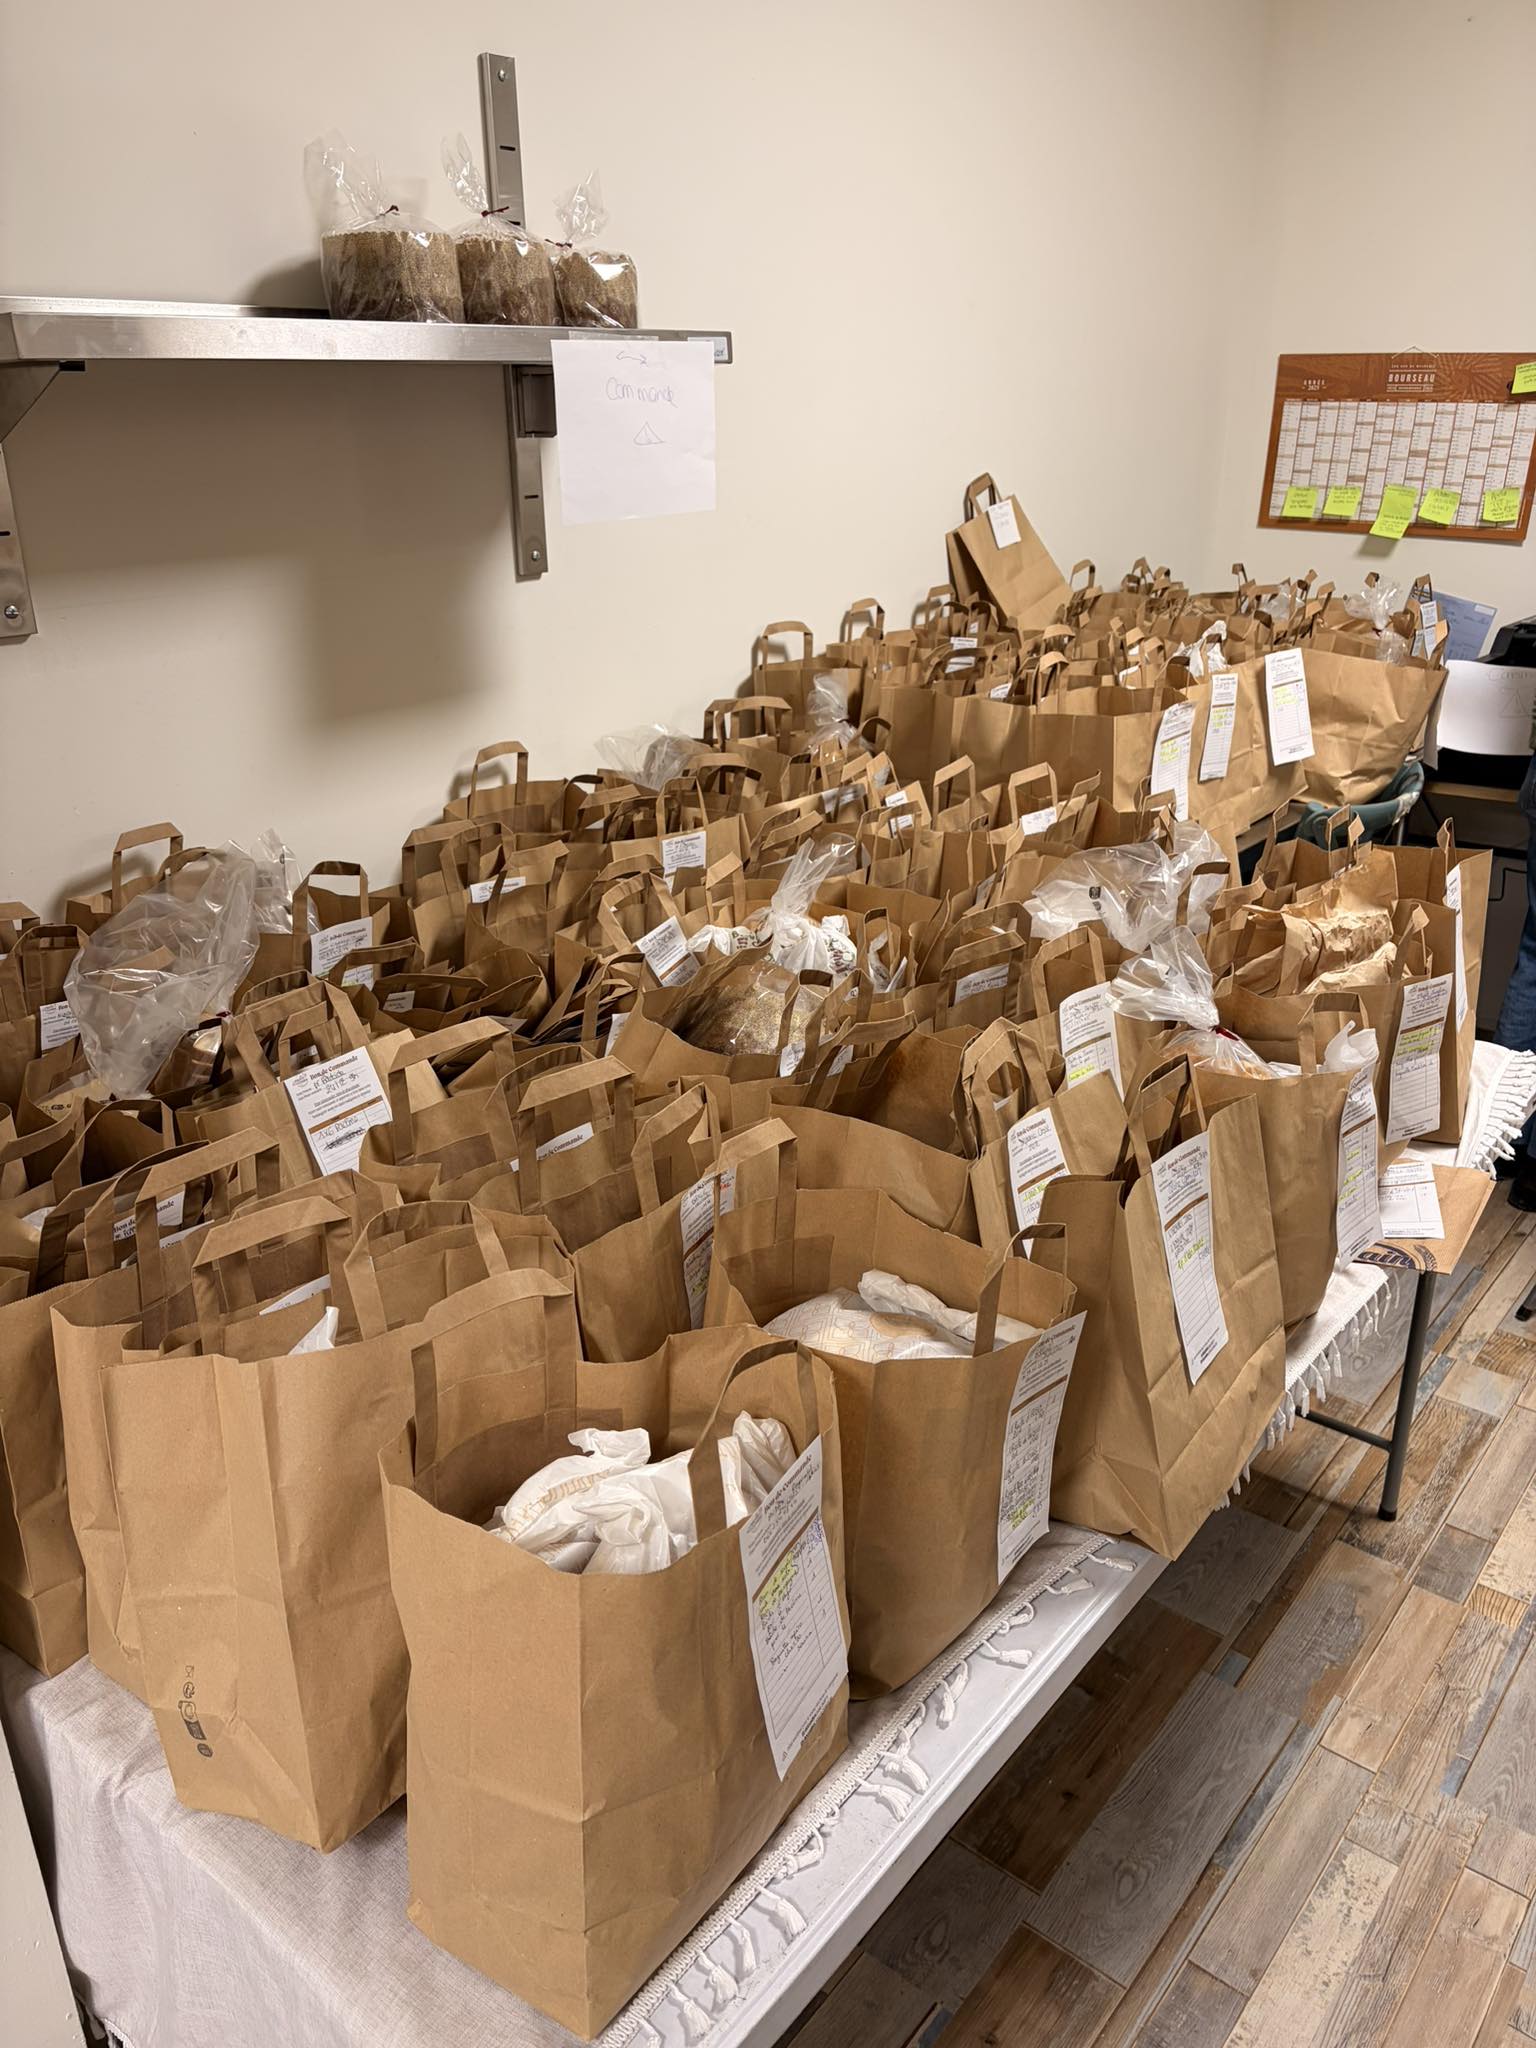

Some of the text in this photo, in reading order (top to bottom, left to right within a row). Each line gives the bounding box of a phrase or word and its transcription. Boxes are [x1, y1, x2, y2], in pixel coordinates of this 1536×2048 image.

[1388, 373, 1436, 383] BOURSEAU
[328, 1055, 358, 1072] Commande
[553, 1134, 584, 1153] Commande
